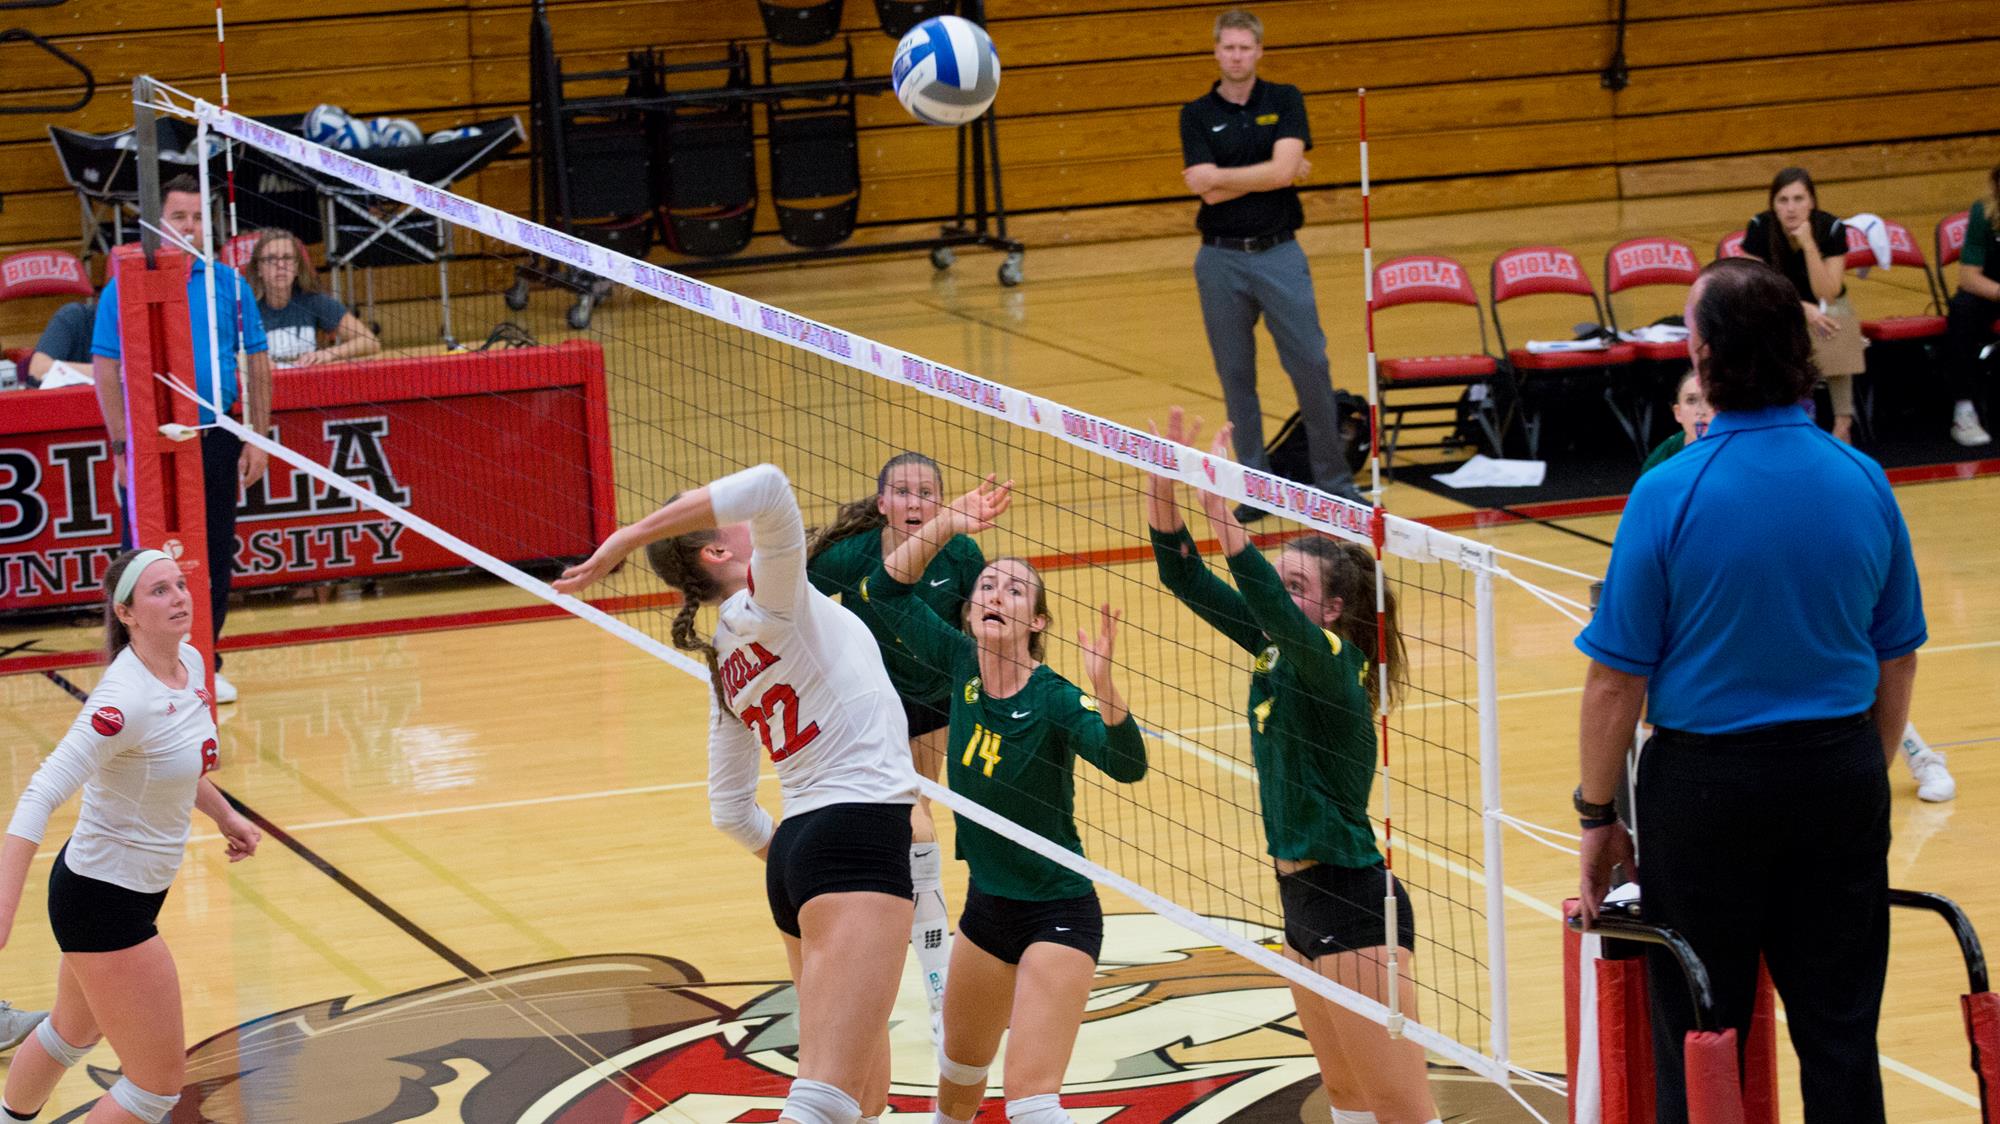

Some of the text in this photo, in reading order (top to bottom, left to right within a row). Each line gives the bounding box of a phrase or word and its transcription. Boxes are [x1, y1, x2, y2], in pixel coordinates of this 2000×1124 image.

[5, 257, 77, 284] BIOLA
[1502, 253, 1576, 282] BIOLA
[1617, 244, 1691, 273] BIOLA
[1383, 263, 1459, 290] BIOLA
[740, 683, 821, 763] 22
[961, 722, 1002, 778] 14
